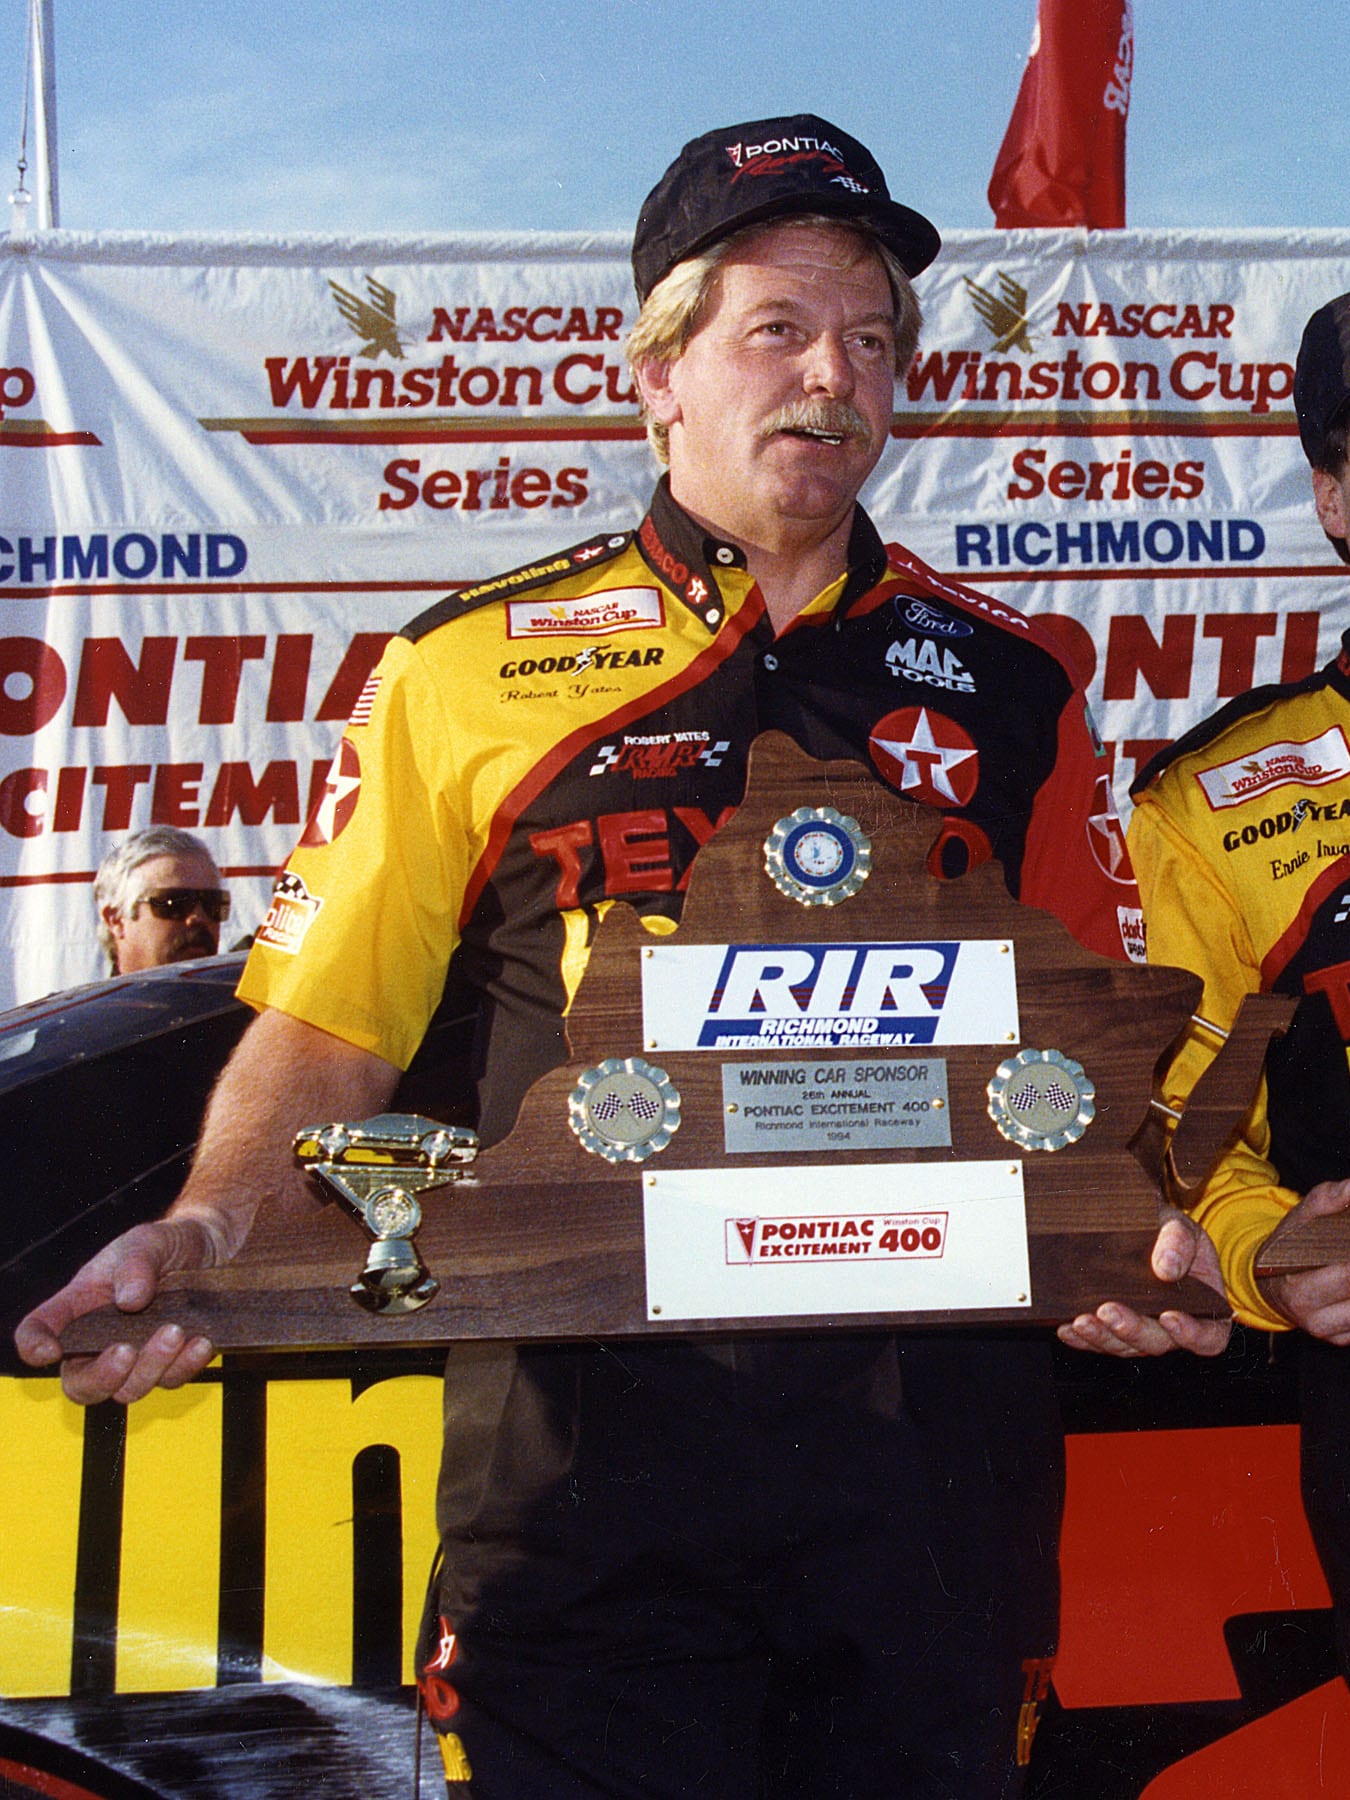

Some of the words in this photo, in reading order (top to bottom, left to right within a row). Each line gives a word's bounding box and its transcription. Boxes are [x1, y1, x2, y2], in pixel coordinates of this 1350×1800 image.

[746, 137, 844, 163] PONTIAC
[428, 306, 624, 342] NASCAR
[1052, 303, 1235, 339] NASCAR
[264, 355, 544, 409] Winston
[553, 353, 641, 406] Cu
[906, 350, 1160, 402] Winston
[1170, 350, 1295, 413] Cup
[378, 457, 589, 511] Series
[1007, 449, 1205, 501] Series
[955, 519, 1266, 567] RICHMOND
[529, 614, 601, 628] Winston
[602, 607, 638, 623] Cup
[573, 602, 620, 617] NASCAR
[904, 601, 959, 635] Ford
[884, 637, 976, 684] MAC
[884, 661, 978, 693] TOOLS
[500, 684, 560, 704] Robert
[624, 735, 672, 746] ROBERT
[672, 731, 710, 743] YATES
[1232, 761, 1297, 792] Winston
[1296, 763, 1323, 777] Cup
[1269, 849, 1312, 882] Ernie
[717, 948, 946, 1014] RIR
[713, 1033, 834, 1048] INTERNATIONAL
[837, 1031, 916, 1046] RACEWAY
[759, 1017, 879, 1035] RICHMOND
[739, 1068, 807, 1086] WINNING
[814, 1067, 847, 1084] CAR
[854, 1065, 929, 1083] SPONSOR
[743, 1104, 805, 1118] PONTIAC
[811, 1101, 896, 1116] EXCITEMENT
[902, 1100, 931, 1113] 400
[830, 1088, 872, 1100] ANNUAL
[755, 1120, 804, 1132] Richmond
[874, 1117, 922, 1130] Raceway
[761, 1219, 875, 1241] PONTIAC
[879, 1226, 942, 1253] 400
[922, 1215, 942, 1227] Cup
[759, 1241, 872, 1258] EXCITEMENT
